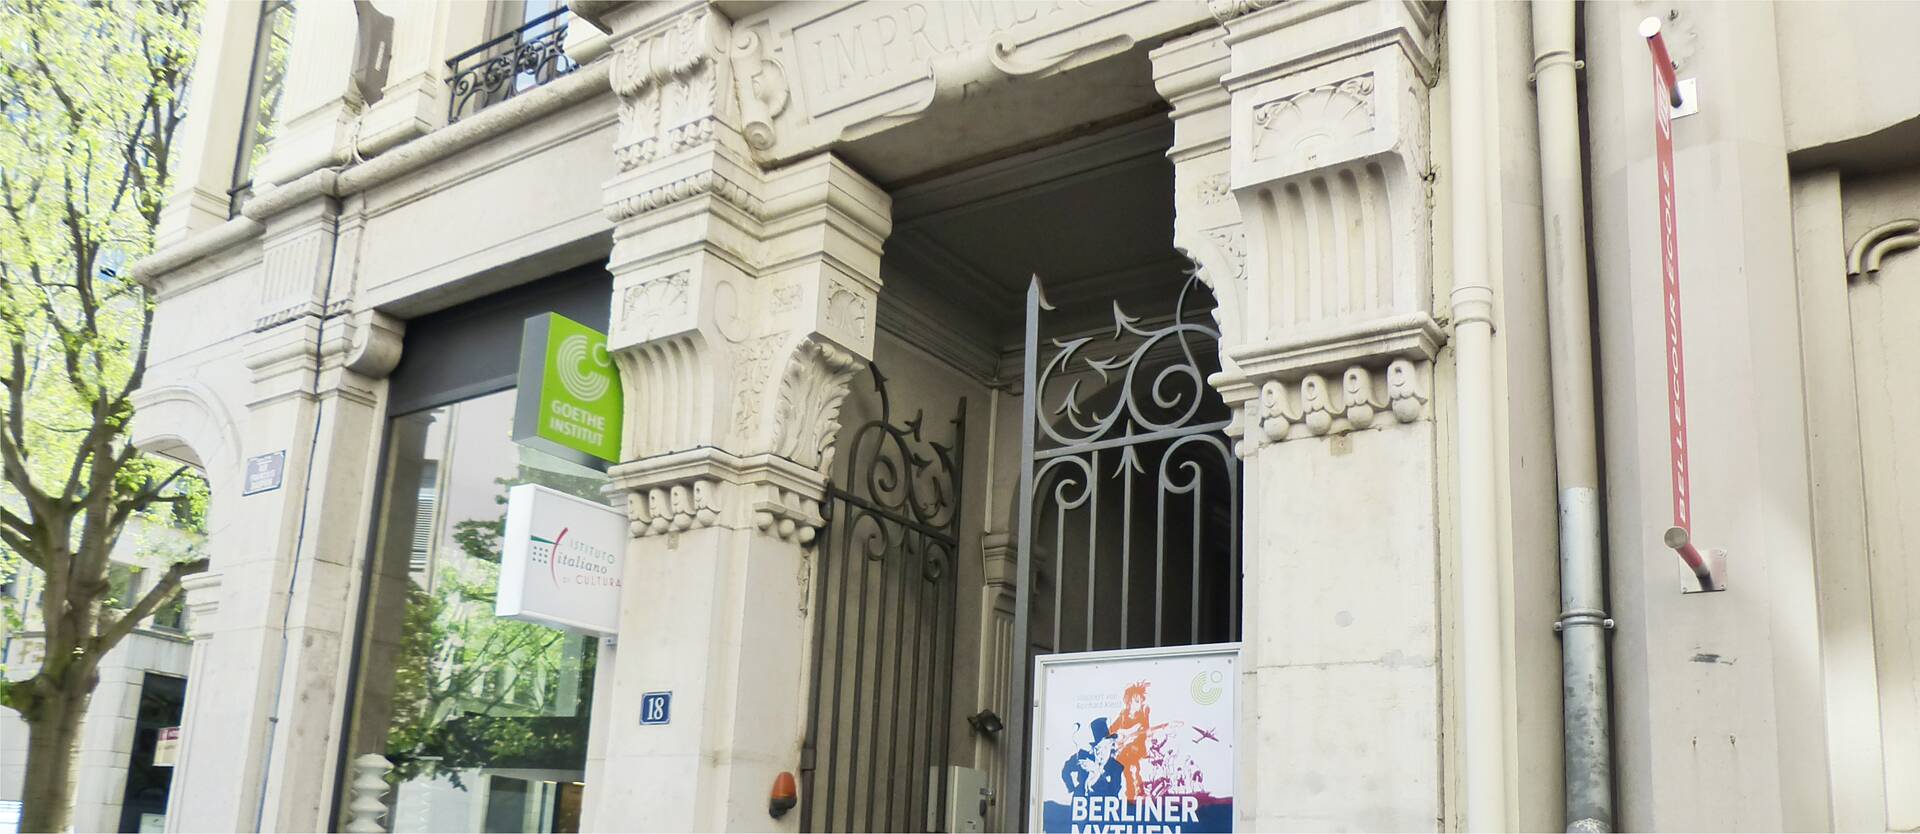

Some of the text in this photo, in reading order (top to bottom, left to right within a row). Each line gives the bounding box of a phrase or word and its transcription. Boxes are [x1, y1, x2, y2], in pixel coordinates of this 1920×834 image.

[551, 400, 606, 431] GOETHE
[1668, 293, 1686, 523] BELLECOUR
[549, 417, 604, 446] INSTITUT
[557, 551, 608, 574] italiano
[570, 540, 616, 564] ISTITUTO
[575, 574, 623, 588] CULTURA
[647, 697, 665, 721] 18
[1071, 796, 1200, 823] BERLINER
